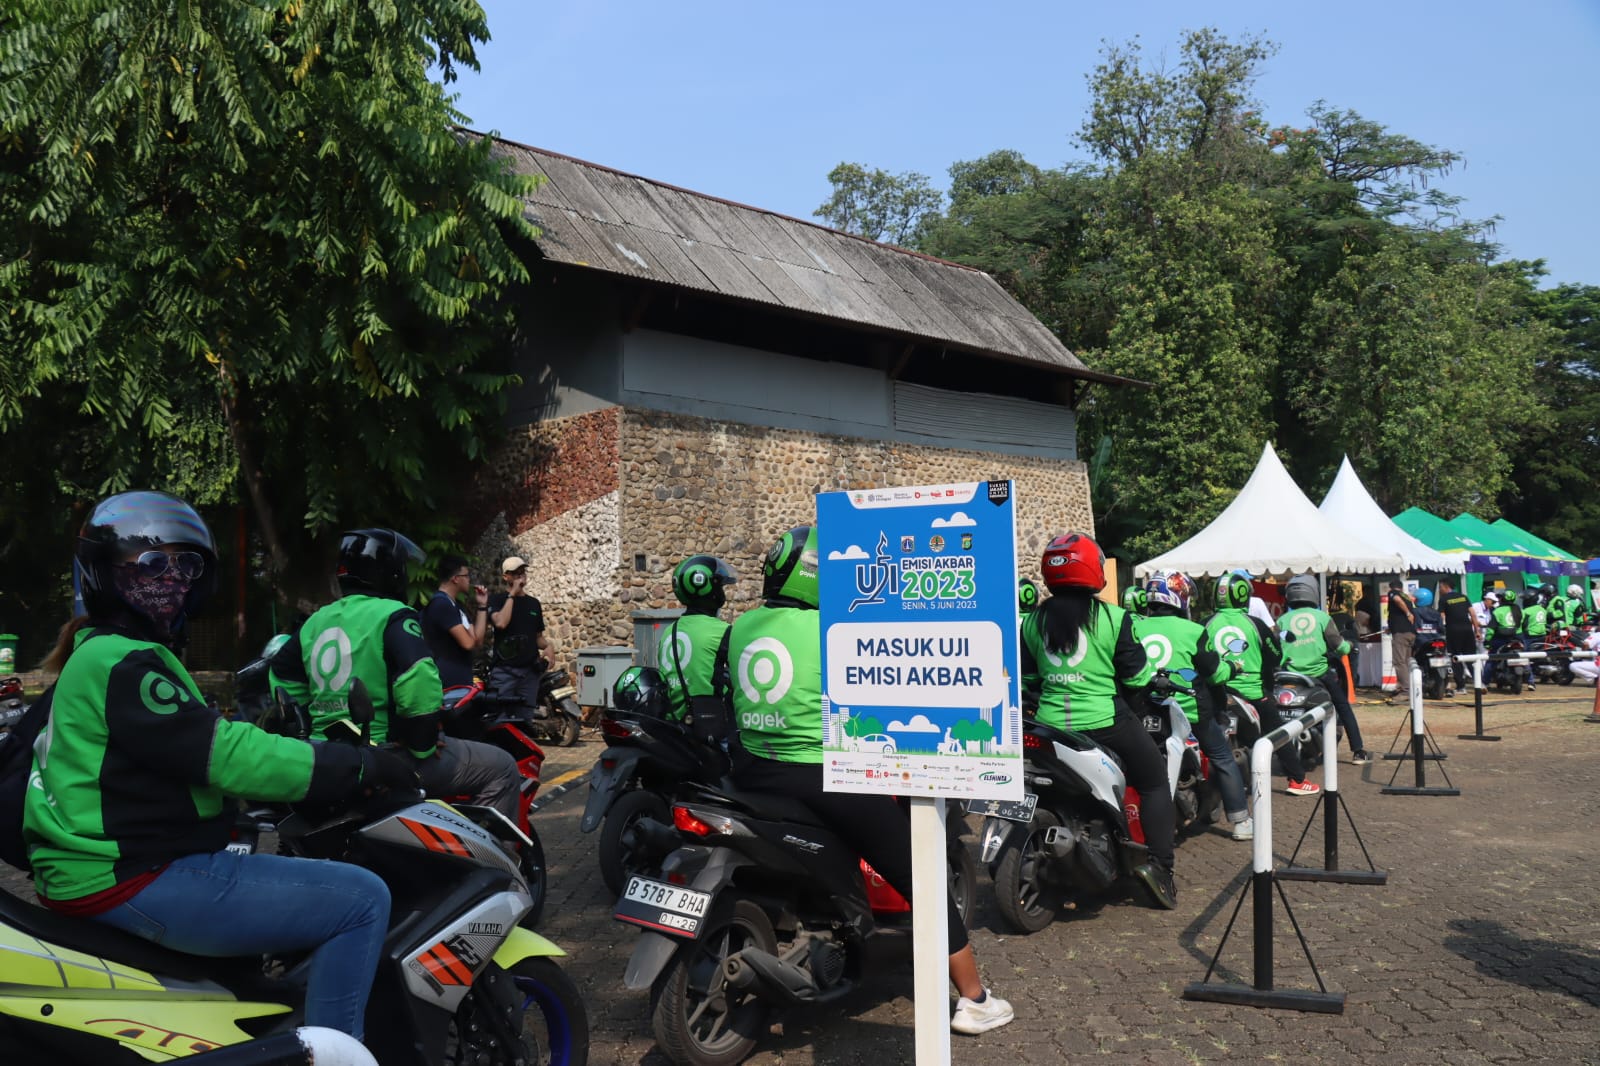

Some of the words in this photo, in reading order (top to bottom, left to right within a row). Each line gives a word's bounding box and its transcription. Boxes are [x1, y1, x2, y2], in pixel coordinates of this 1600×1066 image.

[902, 558, 932, 570] EMISI
[935, 557, 973, 569] AKBAR
[902, 570, 975, 598] 2023
[902, 601, 929, 610] SENIN,
[930, 601, 936, 609] 5
[937, 601, 955, 609] JUNI
[956, 600, 977, 609] 2023
[857, 638, 934, 657] MASUK
[939, 638, 969, 657] UJI
[846, 666, 901, 685] EMISI
[906, 667, 983, 686] AKBAR
[742, 712, 787, 730] gojek
[628, 880, 639, 896] B
[640, 884, 674, 905] 5787
[678, 893, 705, 914] BHA
[469, 923, 502, 934] YAMAHA
